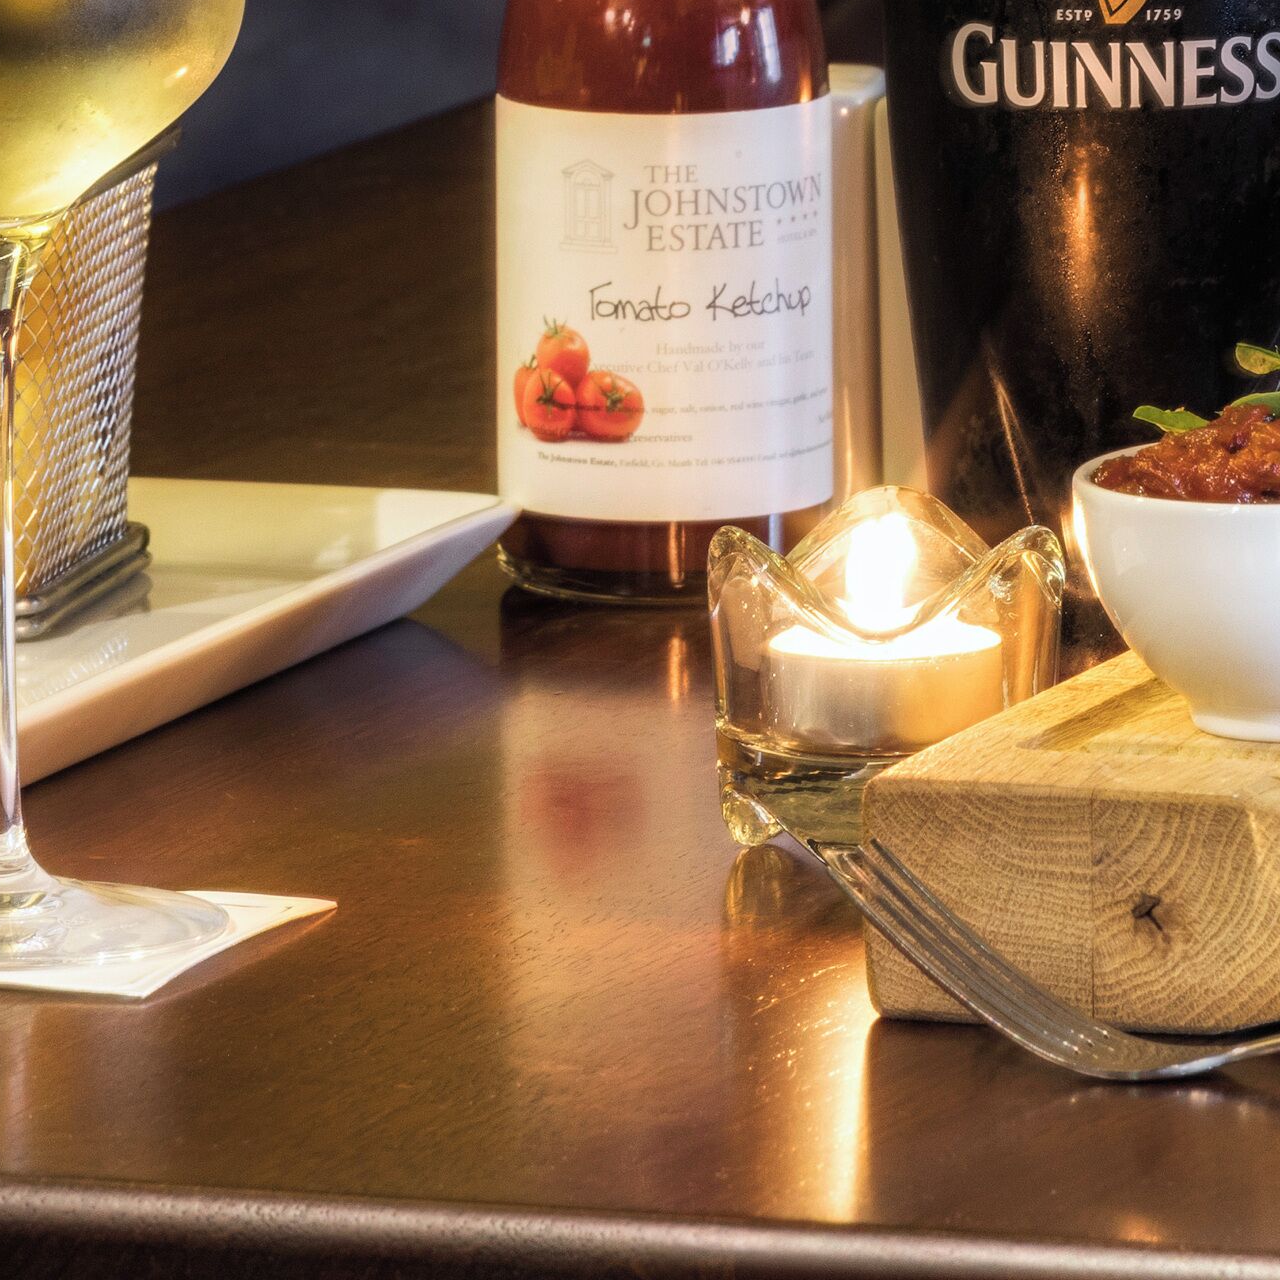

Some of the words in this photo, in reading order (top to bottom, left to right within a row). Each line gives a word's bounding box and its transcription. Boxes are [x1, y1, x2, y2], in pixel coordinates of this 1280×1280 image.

[1145, 8, 1183, 21] 1759
[643, 164, 699, 185] THE
[623, 172, 822, 230] JOHNSTOWN
[645, 220, 765, 253] ESTATE
[588, 281, 692, 322] Tomato
[705, 277, 812, 322] Ketchup
[656, 342, 725, 356] Handmade
[729, 341, 744, 355] by
[646, 360, 679, 373] Chef
[682, 360, 705, 373] Val
[707, 357, 754, 374] O'Kelly
[757, 355, 776, 368] and
[626, 431, 693, 443] Preservatives
